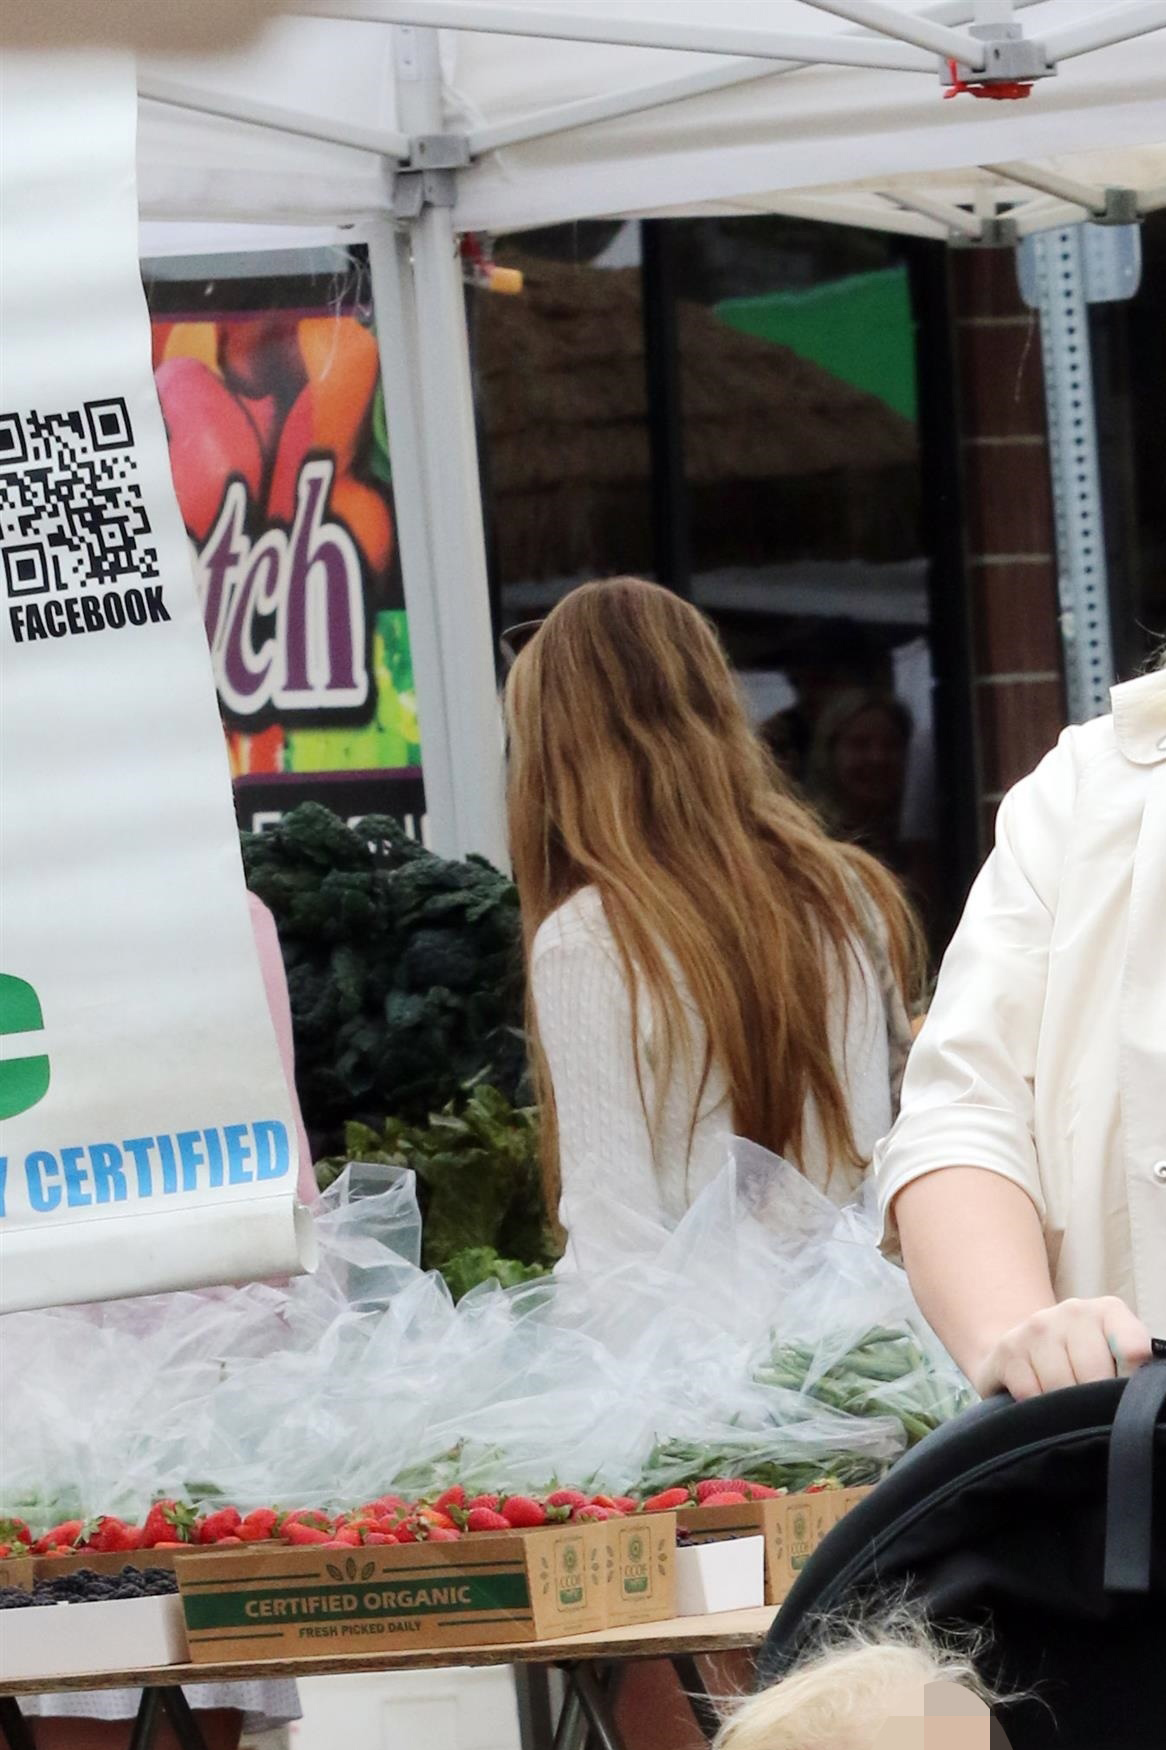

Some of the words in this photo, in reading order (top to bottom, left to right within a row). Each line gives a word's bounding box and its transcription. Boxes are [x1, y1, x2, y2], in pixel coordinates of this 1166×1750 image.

[9, 585, 171, 643] FACEBOOK
[24, 1120, 290, 1212] CERTIFIED
[245, 1593, 358, 1618] CERTIFIED
[363, 1585, 472, 1610] ORGANIC
[299, 1624, 338, 1639] FRESH
[341, 1622, 385, 1636] PICKED
[388, 1620, 422, 1634] DAILY
